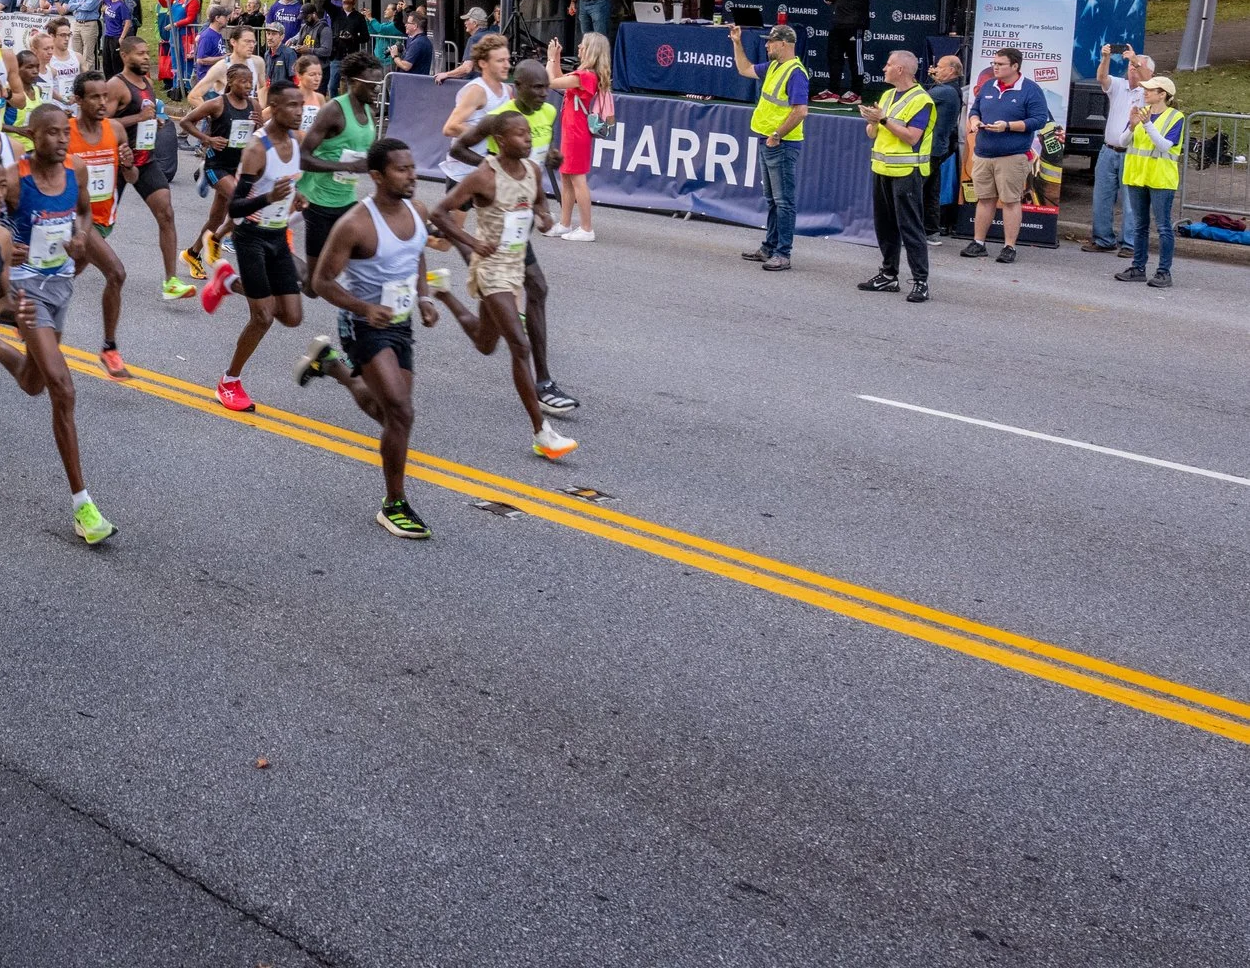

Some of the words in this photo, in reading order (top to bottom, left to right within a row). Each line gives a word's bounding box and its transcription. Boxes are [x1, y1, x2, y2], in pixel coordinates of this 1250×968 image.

[788, 7, 818, 15] L3HARRIS
[904, 13, 936, 21] L3HARRIS
[873, 33, 905, 41] L3HARRIS
[982, 40, 1043, 49] FIREFIGHTERS
[677, 50, 733, 68] L3HARRIS
[144, 132, 154, 140] 44
[238, 131, 248, 140] 57
[91, 180, 105, 190] 13
[397, 295, 410, 308] 16
